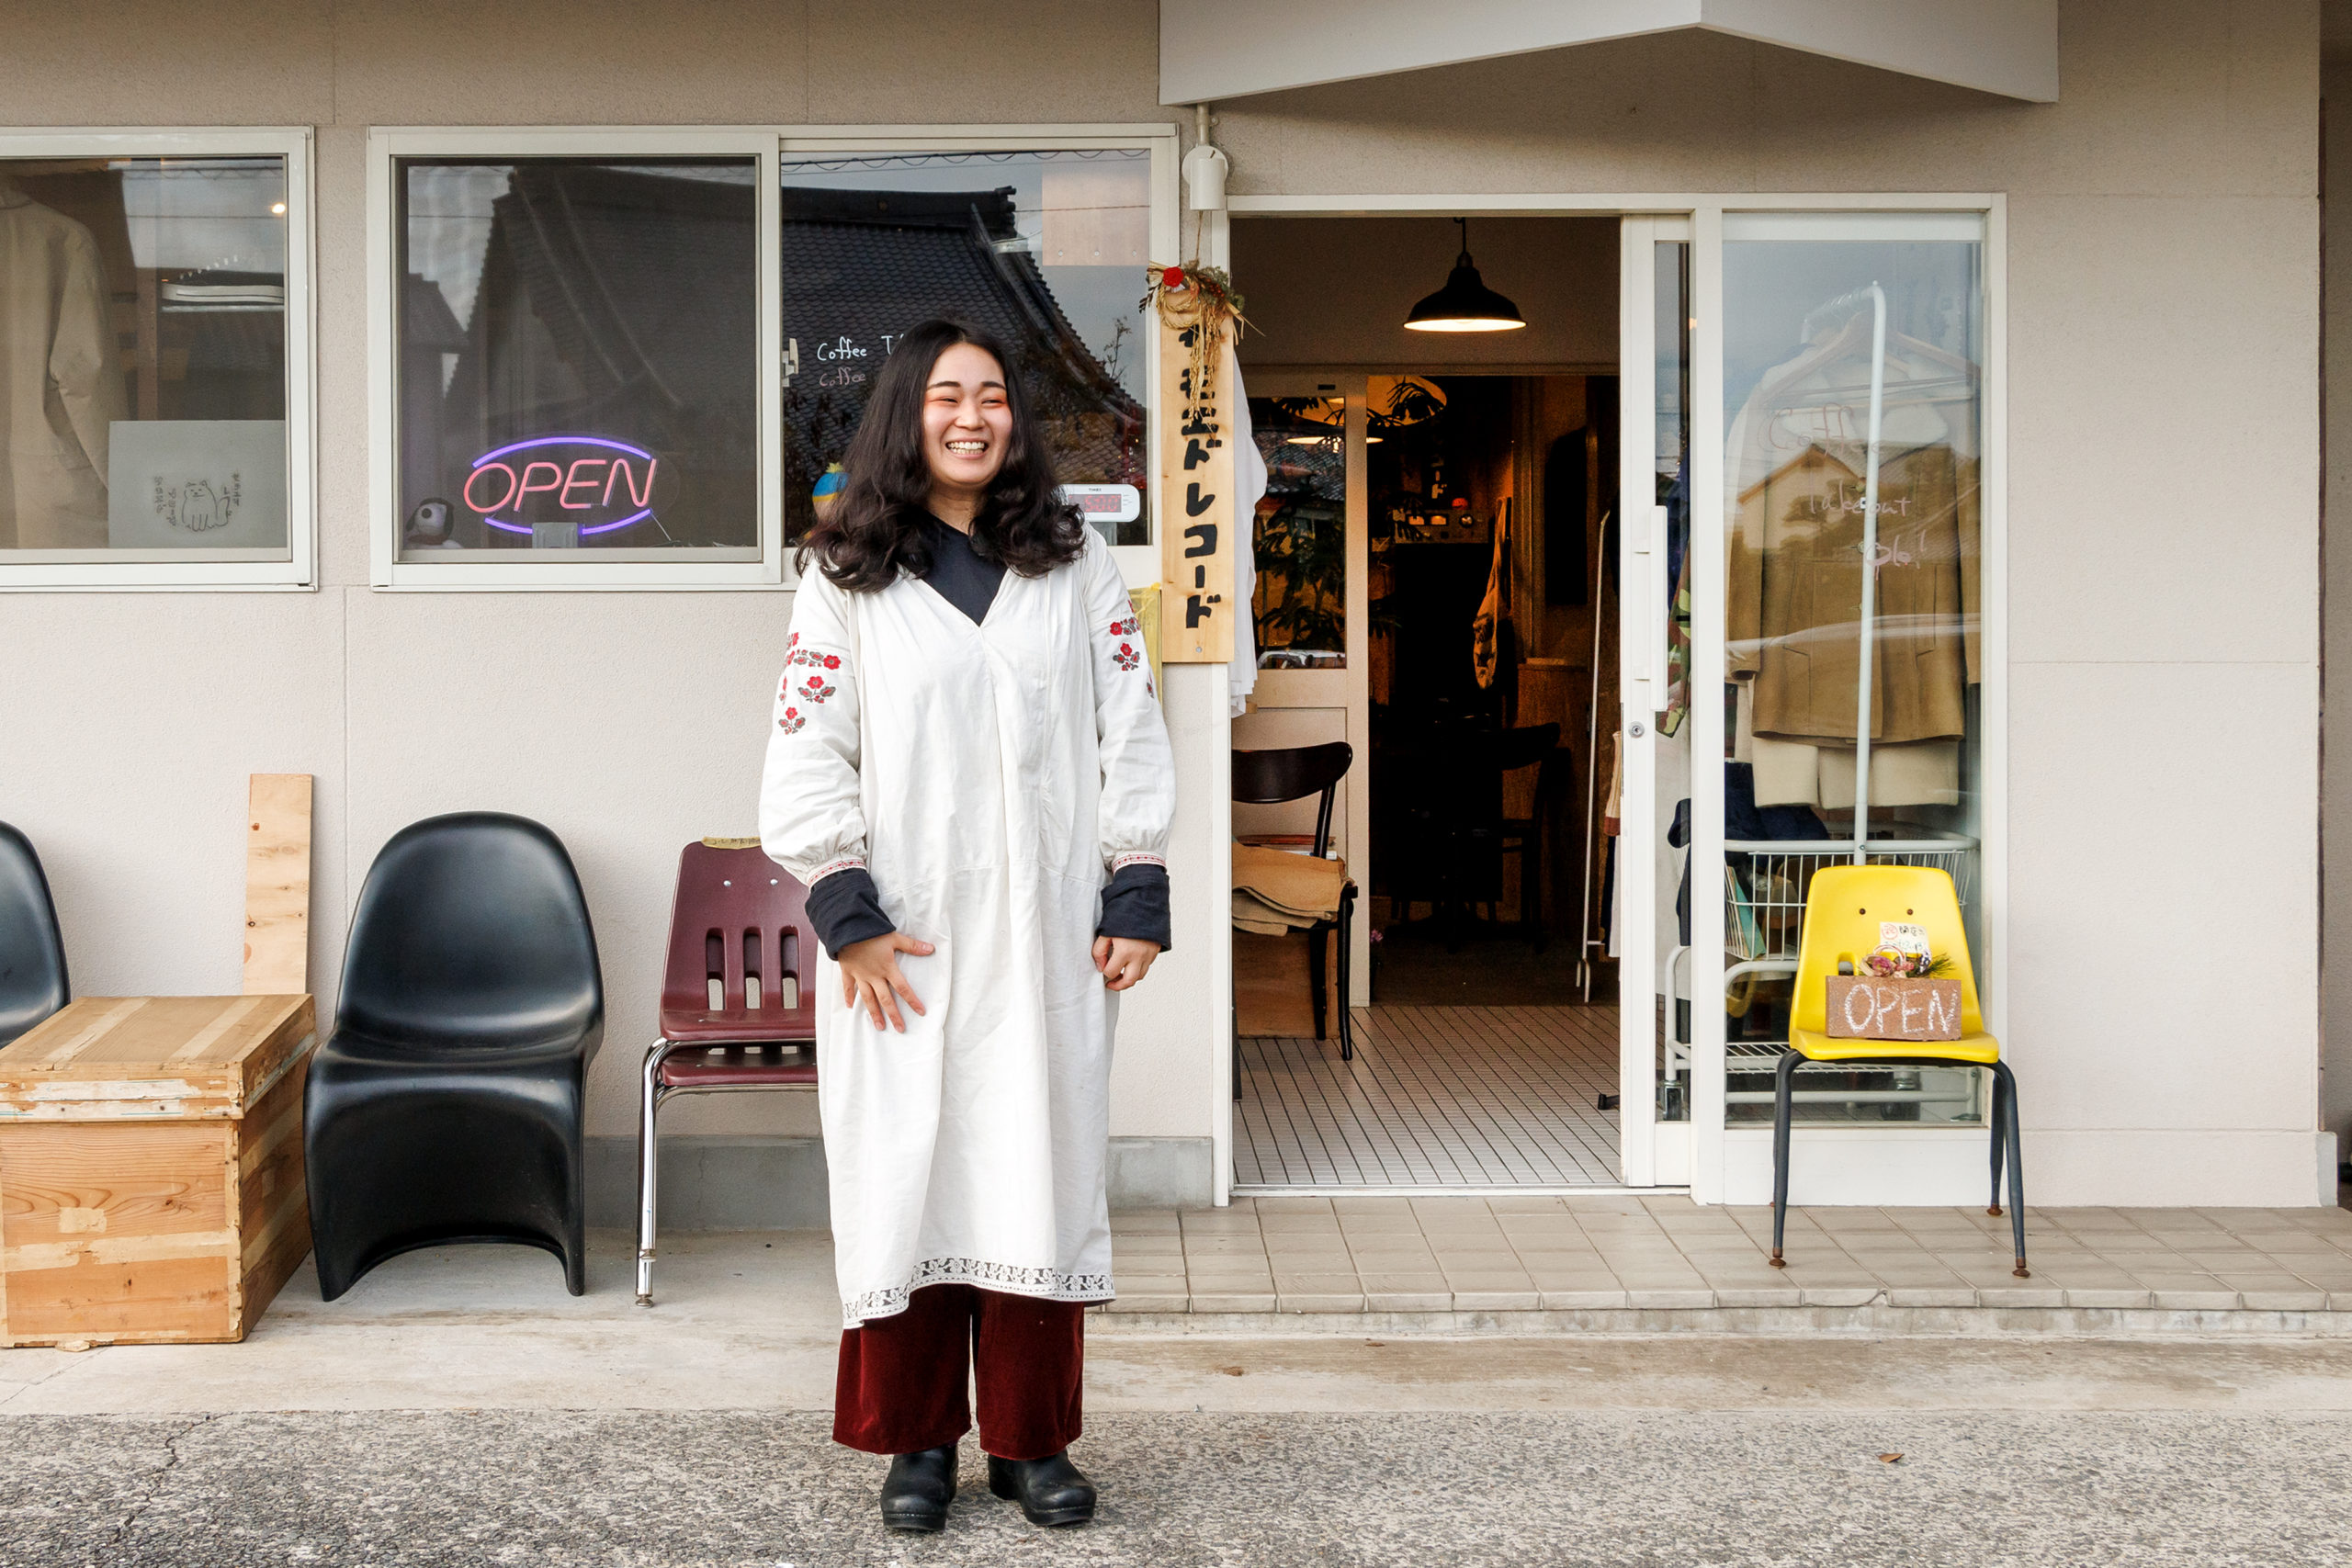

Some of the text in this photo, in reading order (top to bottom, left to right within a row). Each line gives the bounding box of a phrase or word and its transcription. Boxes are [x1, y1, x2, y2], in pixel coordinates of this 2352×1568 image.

[817, 336, 867, 361] Coffee
[464, 458, 657, 514] OPEN
[1843, 983, 1958, 1035] OPEN
